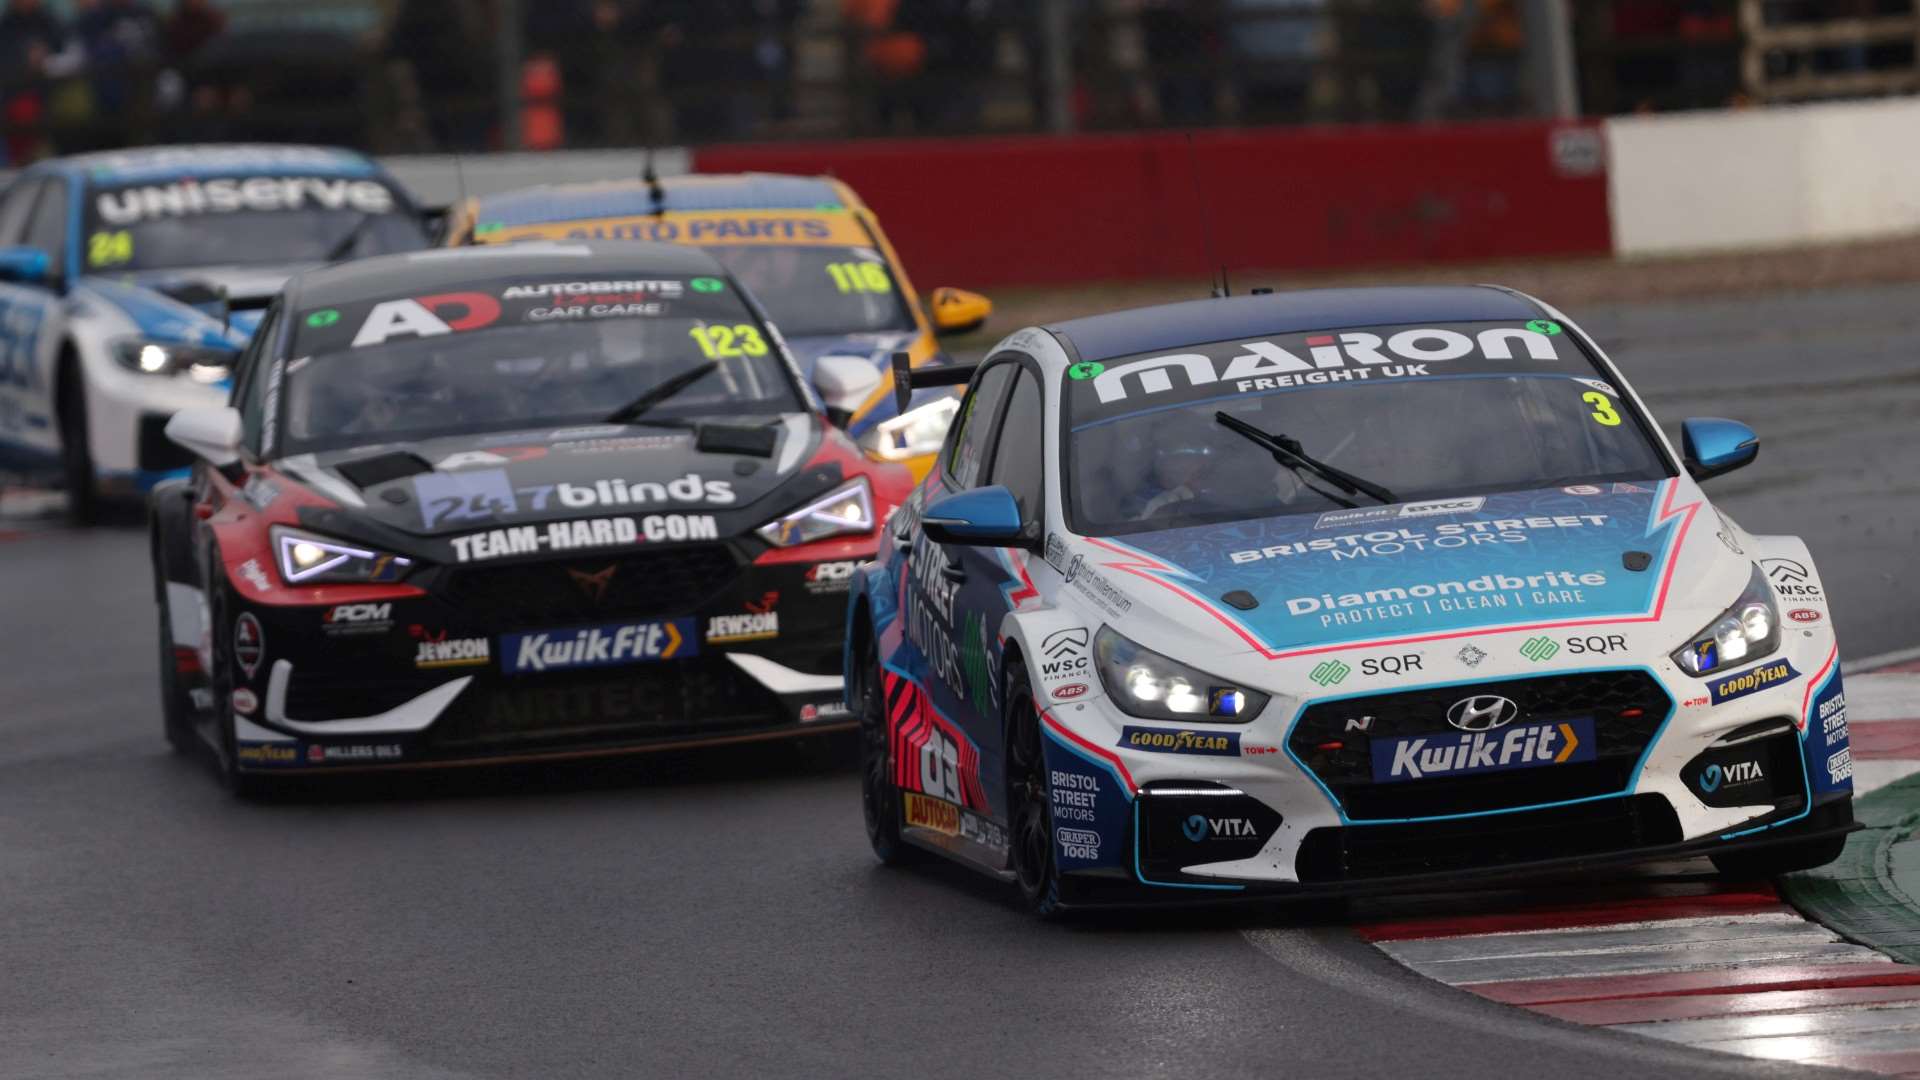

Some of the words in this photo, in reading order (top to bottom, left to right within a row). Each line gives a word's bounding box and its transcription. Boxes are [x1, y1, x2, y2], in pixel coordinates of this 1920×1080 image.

[689, 218, 831, 240] PARTS
[89, 230, 133, 267] 24
[827, 261, 890, 294] 116
[502, 280, 684, 299] AUTOBRITE
[527, 306, 586, 322] CAR
[589, 302, 661, 317] CARE
[690, 325, 768, 358] 123
[1236, 368, 1372, 393] FREIGHT
[1381, 363, 1430, 379] UK
[1581, 391, 1620, 426] 3
[557, 473, 736, 507] blinds
[1407, 501, 1475, 513] BTCC
[451, 514, 718, 562] TEAM-HARD.COM
[1229, 527, 1431, 565] BRISTOL
[1436, 514, 1608, 537] STREET
[1331, 530, 1528, 562] MOTORS
[1091, 577, 1132, 612] millennium
[1285, 571, 1607, 617] Diamondbrite
[1774, 584, 1820, 595] WSC
[1321, 602, 1413, 628] PROTECT
[1441, 594, 1507, 612] CLEAN
[1533, 590, 1587, 607] CARE
[1794, 611, 1818, 620] ABS
[706, 612, 779, 638] JEWSON
[414, 637, 490, 661] JEWSON
[1565, 634, 1628, 654] SQR
[1042, 657, 1088, 674] WSC
[1044, 670, 1088, 681] FINANCE
[1361, 654, 1424, 676] SQR
[1058, 686, 1083, 697] ABS
[1693, 697, 1709, 707] TOW
[817, 702, 850, 716] MILL
[1824, 707, 1847, 734] STREET
[1244, 745, 1266, 755] TOW
[1051, 771, 1100, 791] BRISTOL
[1722, 760, 1764, 784] VITA
[1052, 789, 1097, 807] STREET
[1053, 806, 1096, 822] MOTORS
[1208, 817, 1257, 836] VITA
[1058, 831, 1098, 846] DRAPER
[1061, 844, 1099, 860] Tools
